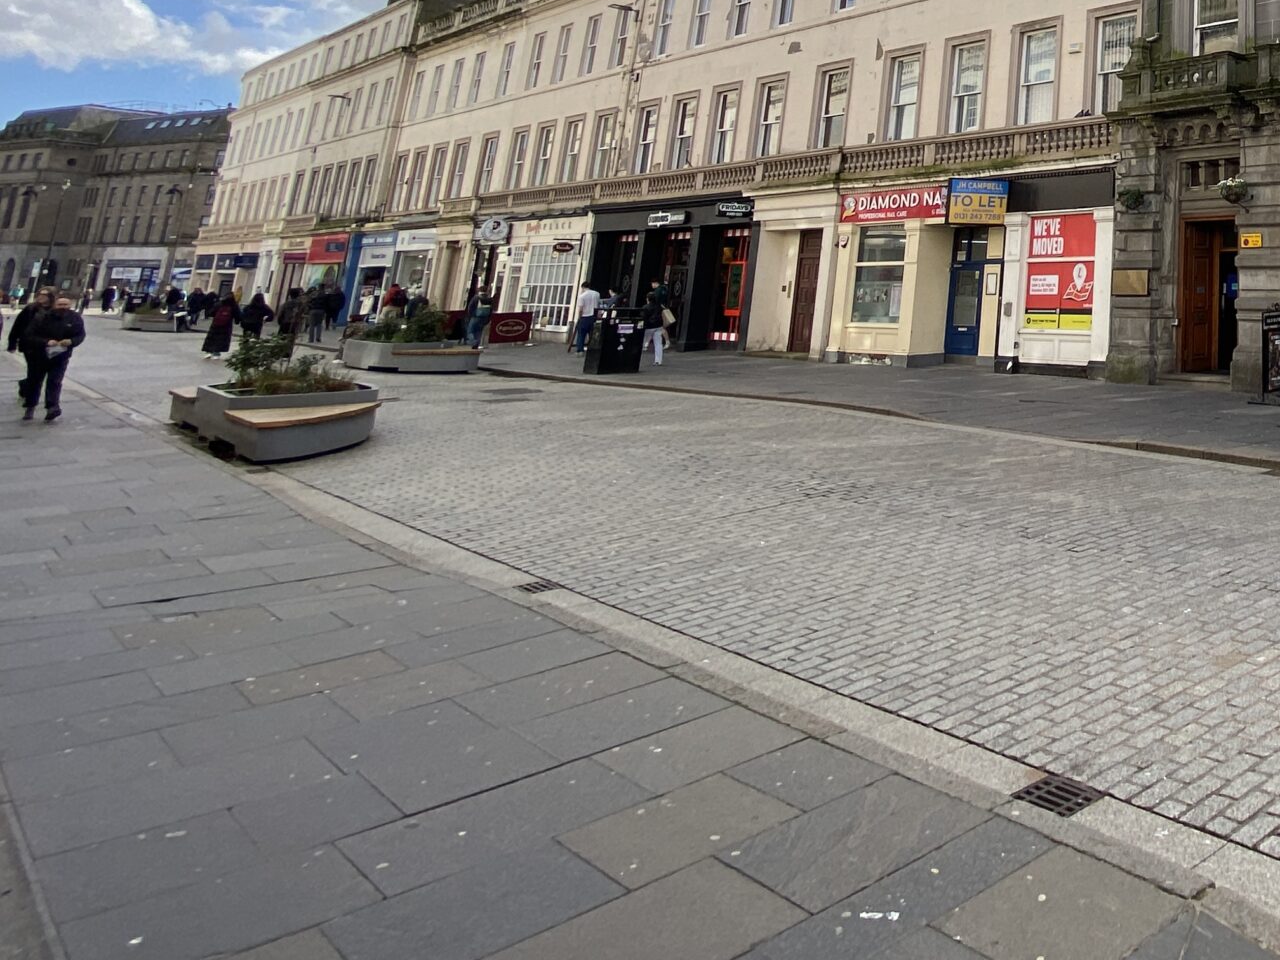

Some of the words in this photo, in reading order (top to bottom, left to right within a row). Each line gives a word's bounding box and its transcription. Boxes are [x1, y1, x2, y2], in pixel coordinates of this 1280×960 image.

[957, 181, 967, 189] JH
[968, 181, 1003, 190] CAMPBELL
[858, 193, 919, 211] DIAMOND
[924, 191, 942, 207] NA
[952, 195, 973, 207] TO
[979, 196, 1006, 208] LET
[1034, 218, 1061, 236] WE'VE
[1032, 237, 1064, 255] MOVED
